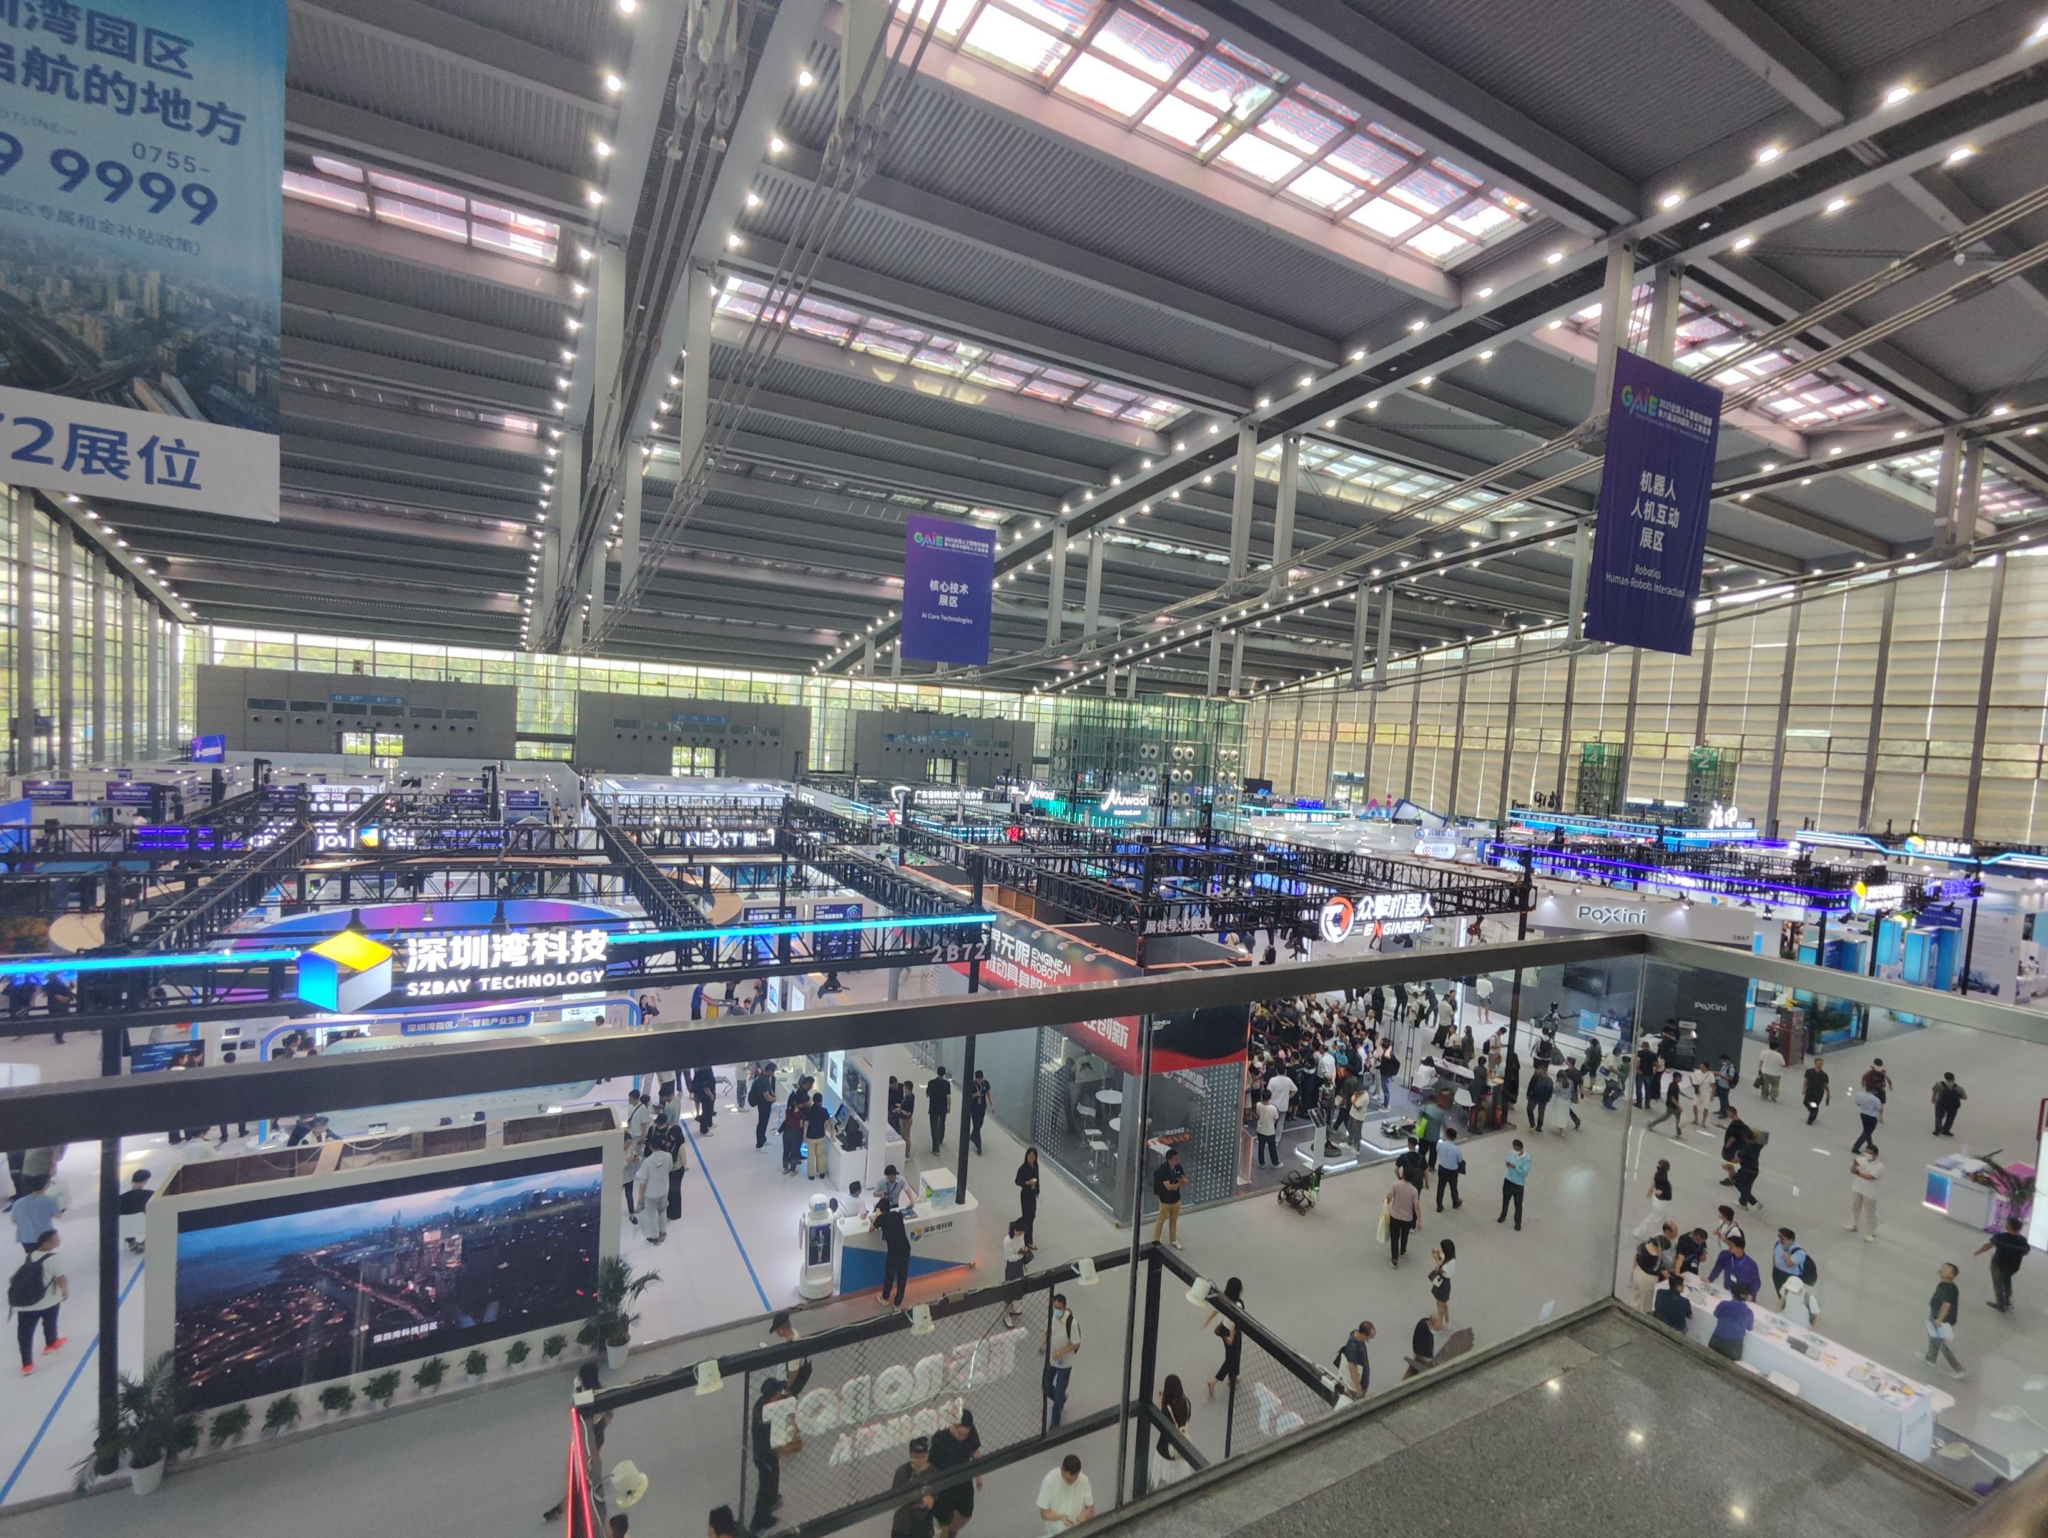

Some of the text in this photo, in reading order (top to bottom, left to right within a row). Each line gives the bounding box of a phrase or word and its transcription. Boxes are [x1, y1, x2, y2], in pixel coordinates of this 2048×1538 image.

[50, 148, 218, 226] 9999
[0, 413, 202, 492] 2展位
[1640, 470, 1677, 501] 机器人
[1630, 497, 1680, 529] 人机互动
[1639, 529, 1664, 552] 展区
[1634, 564, 1662, 580] Robotics
[929, 579, 969, 595] 核心技术
[1605, 571, 1685, 598] Human-Robots Interaction
[938, 595, 958, 608] 展区
[928, 612, 941, 621] Core
[941, 614, 973, 625] Technologies
[1698, 753, 1710, 768] 2
[914, 790, 983, 800] 广东省终端快充业协会
[1355, 892, 1435, 920] 众擎机器人
[1577, 904, 1647, 924] PaXini
[405, 928, 608, 974] 深圳湾科技
[931, 943, 986, 963] 2B72
[1031, 948, 1071, 977] ENGINEAI
[1030, 959, 1059, 982] ROBOT
[407, 970, 606, 997] SZBAY TECHNOLOGY
[1694, 1001, 1727, 1012] PaXini
